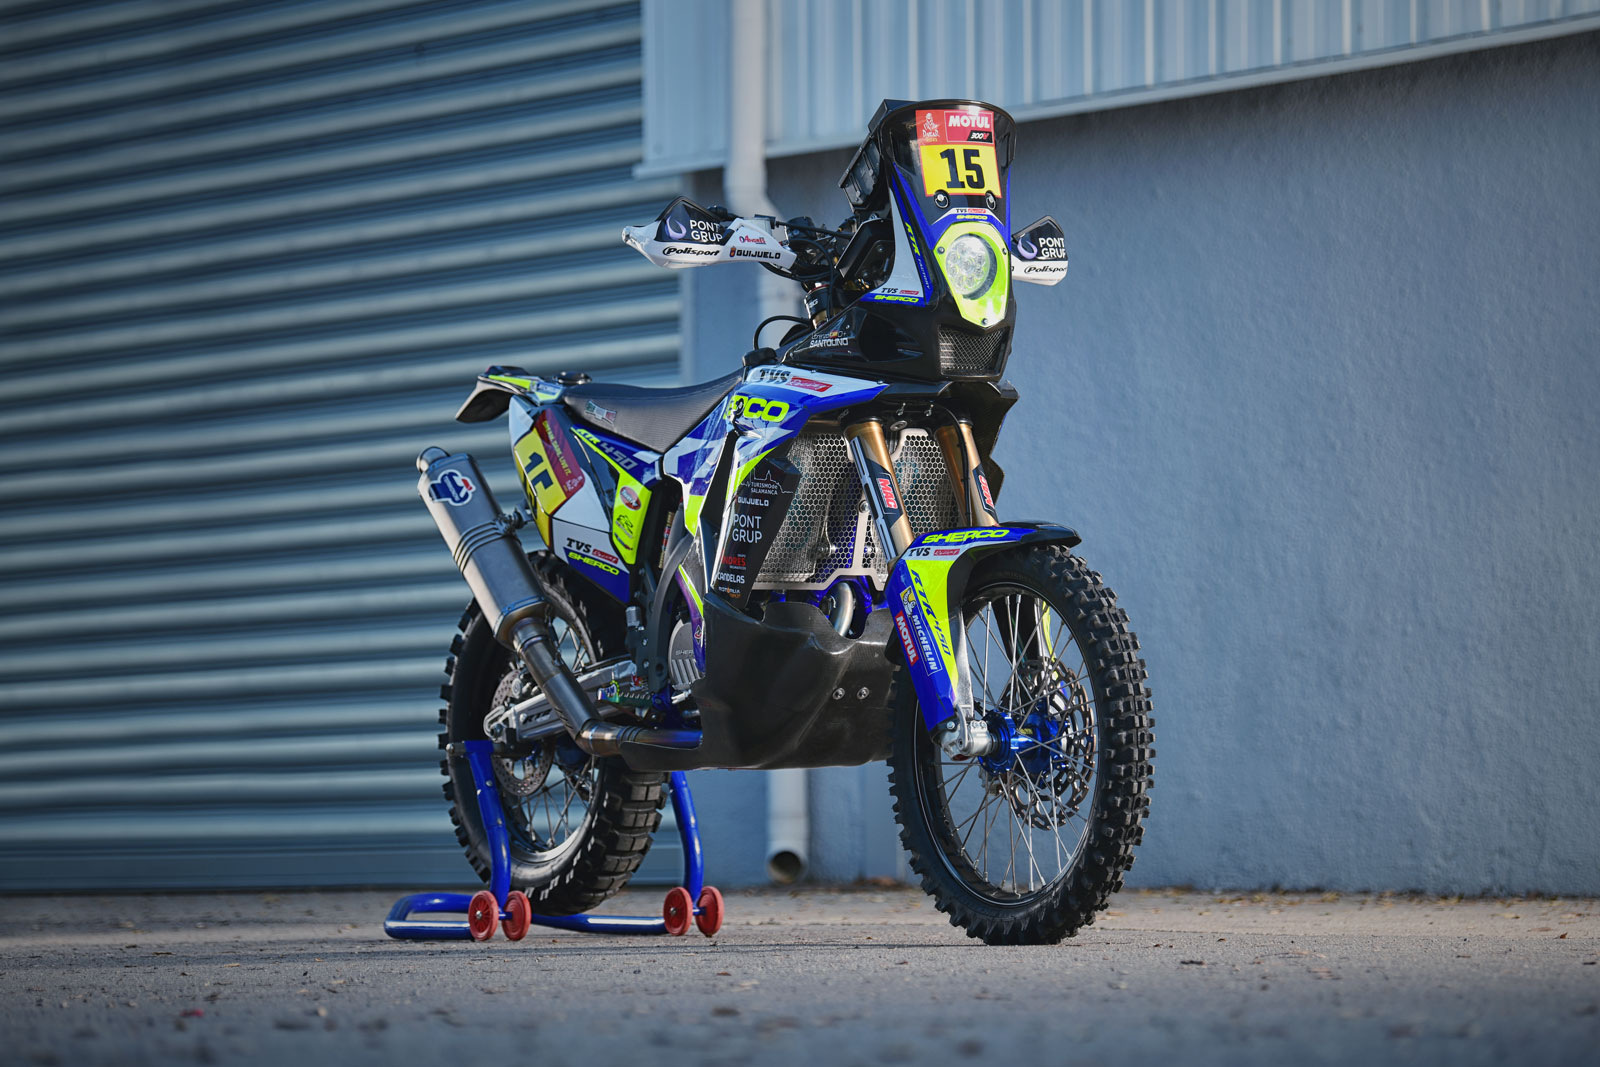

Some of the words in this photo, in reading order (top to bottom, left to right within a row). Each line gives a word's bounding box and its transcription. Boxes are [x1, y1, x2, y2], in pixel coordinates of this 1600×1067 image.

[948, 115, 991, 129] MOTUL
[970, 132, 990, 140] 300V
[940, 148, 986, 189] 15
[690, 219, 720, 233] PONT
[690, 230, 723, 243] GRUP
[1038, 237, 1065, 249] PONT
[663, 246, 720, 257] Polisport
[736, 249, 781, 260] GUIJUELO
[874, 294, 919, 304] SHERCO
[810, 338, 849, 348] SANTOLINO
[760, 368, 791, 385] TVS
[600, 442, 639, 471] 450
[750, 487, 778, 496] SALAMANCA
[737, 496, 769, 507] GUIJUELO
[733, 513, 762, 529] PONT
[732, 528, 763, 544] GRUP
[922, 529, 1010, 544] SHERCO
[567, 537, 592, 554] TVS
[908, 547, 931, 557] TVS
[568, 551, 620, 576] SHERCO
[717, 572, 746, 584] CANDELAS
[896, 615, 917, 663] MOTUL
[912, 614, 938, 671] MICHELIN
